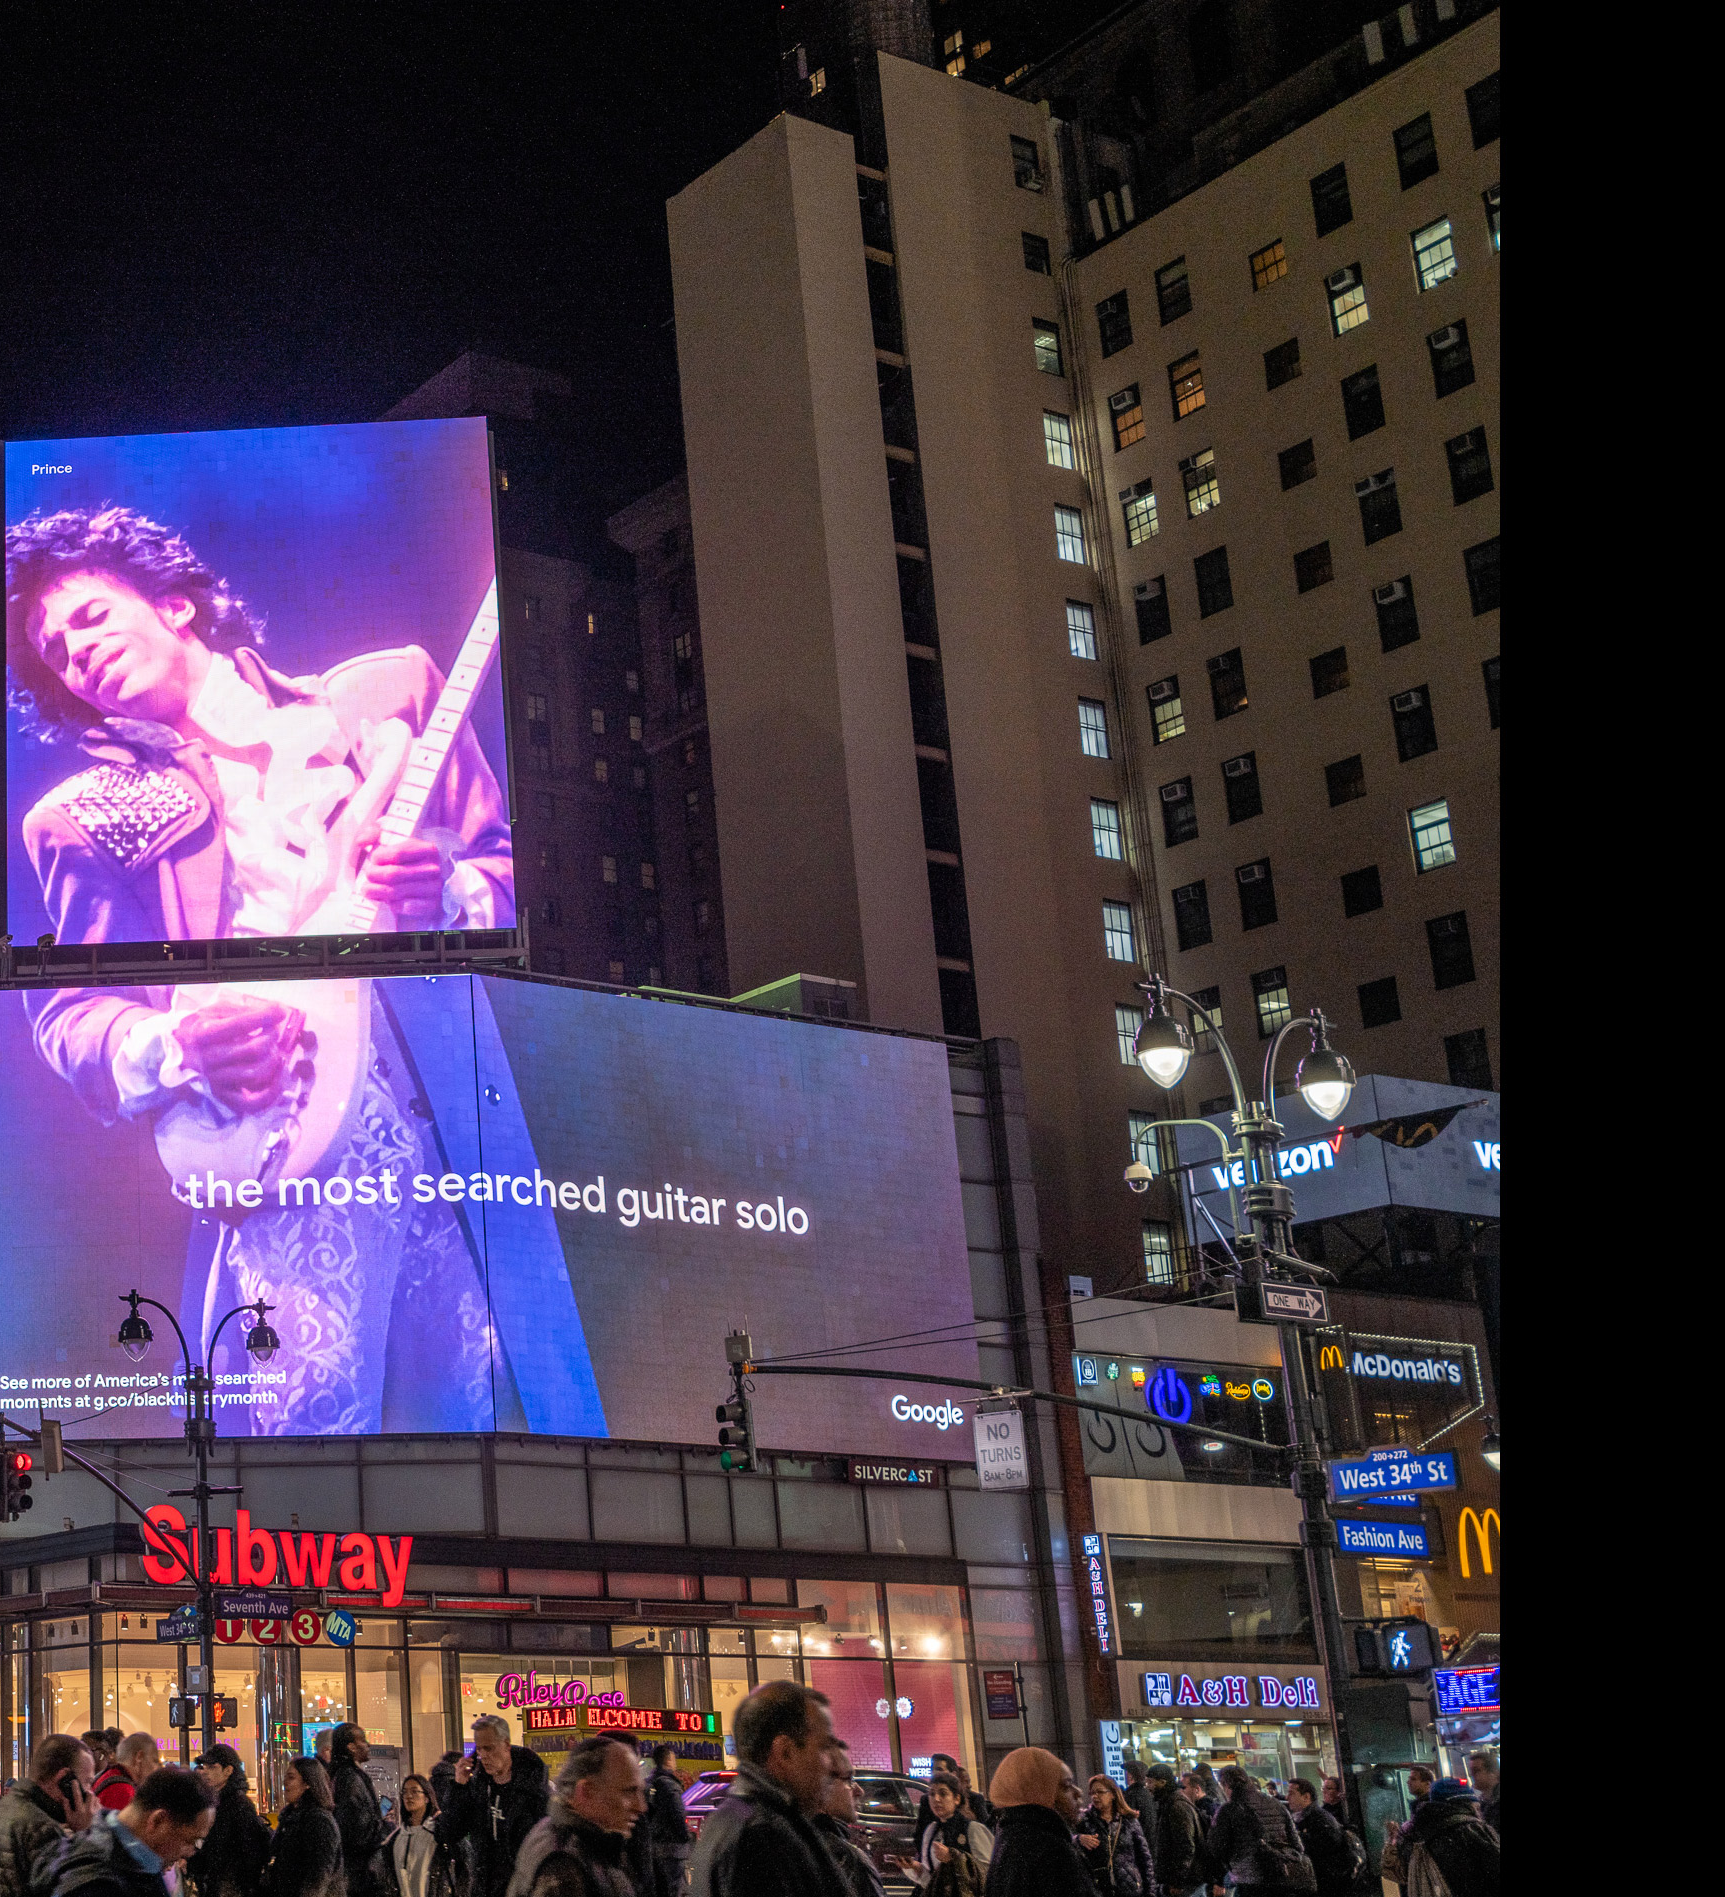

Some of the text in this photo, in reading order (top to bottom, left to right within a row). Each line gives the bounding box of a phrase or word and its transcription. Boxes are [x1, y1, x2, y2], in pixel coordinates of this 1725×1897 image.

[32, 464, 73, 475] Prince
[185, 1171, 809, 1235] the most searched guitar solo
[1273, 1295, 1316, 1311] ONE WAY
[1353, 1353, 1462, 1385] McDonald's
[0, 1375, 28, 1390] See
[32, 1376, 72, 1389] more
[75, 1374, 92, 1388] of
[94, 1371, 170, 1388] America's
[216, 1370, 287, 1385] searched
[0, 1389, 279, 1411] moments at g.co/blackhisorymonth
[891, 1394, 964, 1431] Google
[987, 1423, 1010, 1440] NO
[981, 1446, 1022, 1463] TURNS
[984, 1468, 1023, 1482] 8AM-8PM
[1339, 1460, 1448, 1490] West 34th St
[1343, 1526, 1424, 1550] Fashion Ave
[142, 1504, 413, 1608] Subway
[223, 1600, 288, 1615] Seventh Ave
[160, 1624, 175, 1637] West
[188, 1621, 195, 1634] St
[298, 1615, 314, 1639] 3
[326, 1611, 352, 1640] MTA
[1094, 1599, 1109, 1652] DELI
[498, 1670, 563, 1708] Riley
[1177, 1674, 1320, 1708] A&H Deli
[676, 1713, 702, 1731] TO
[156, 1738, 199, 1750] RILY
[909, 1767, 932, 1777] WERE
[911, 1757, 932, 1767] WISH
